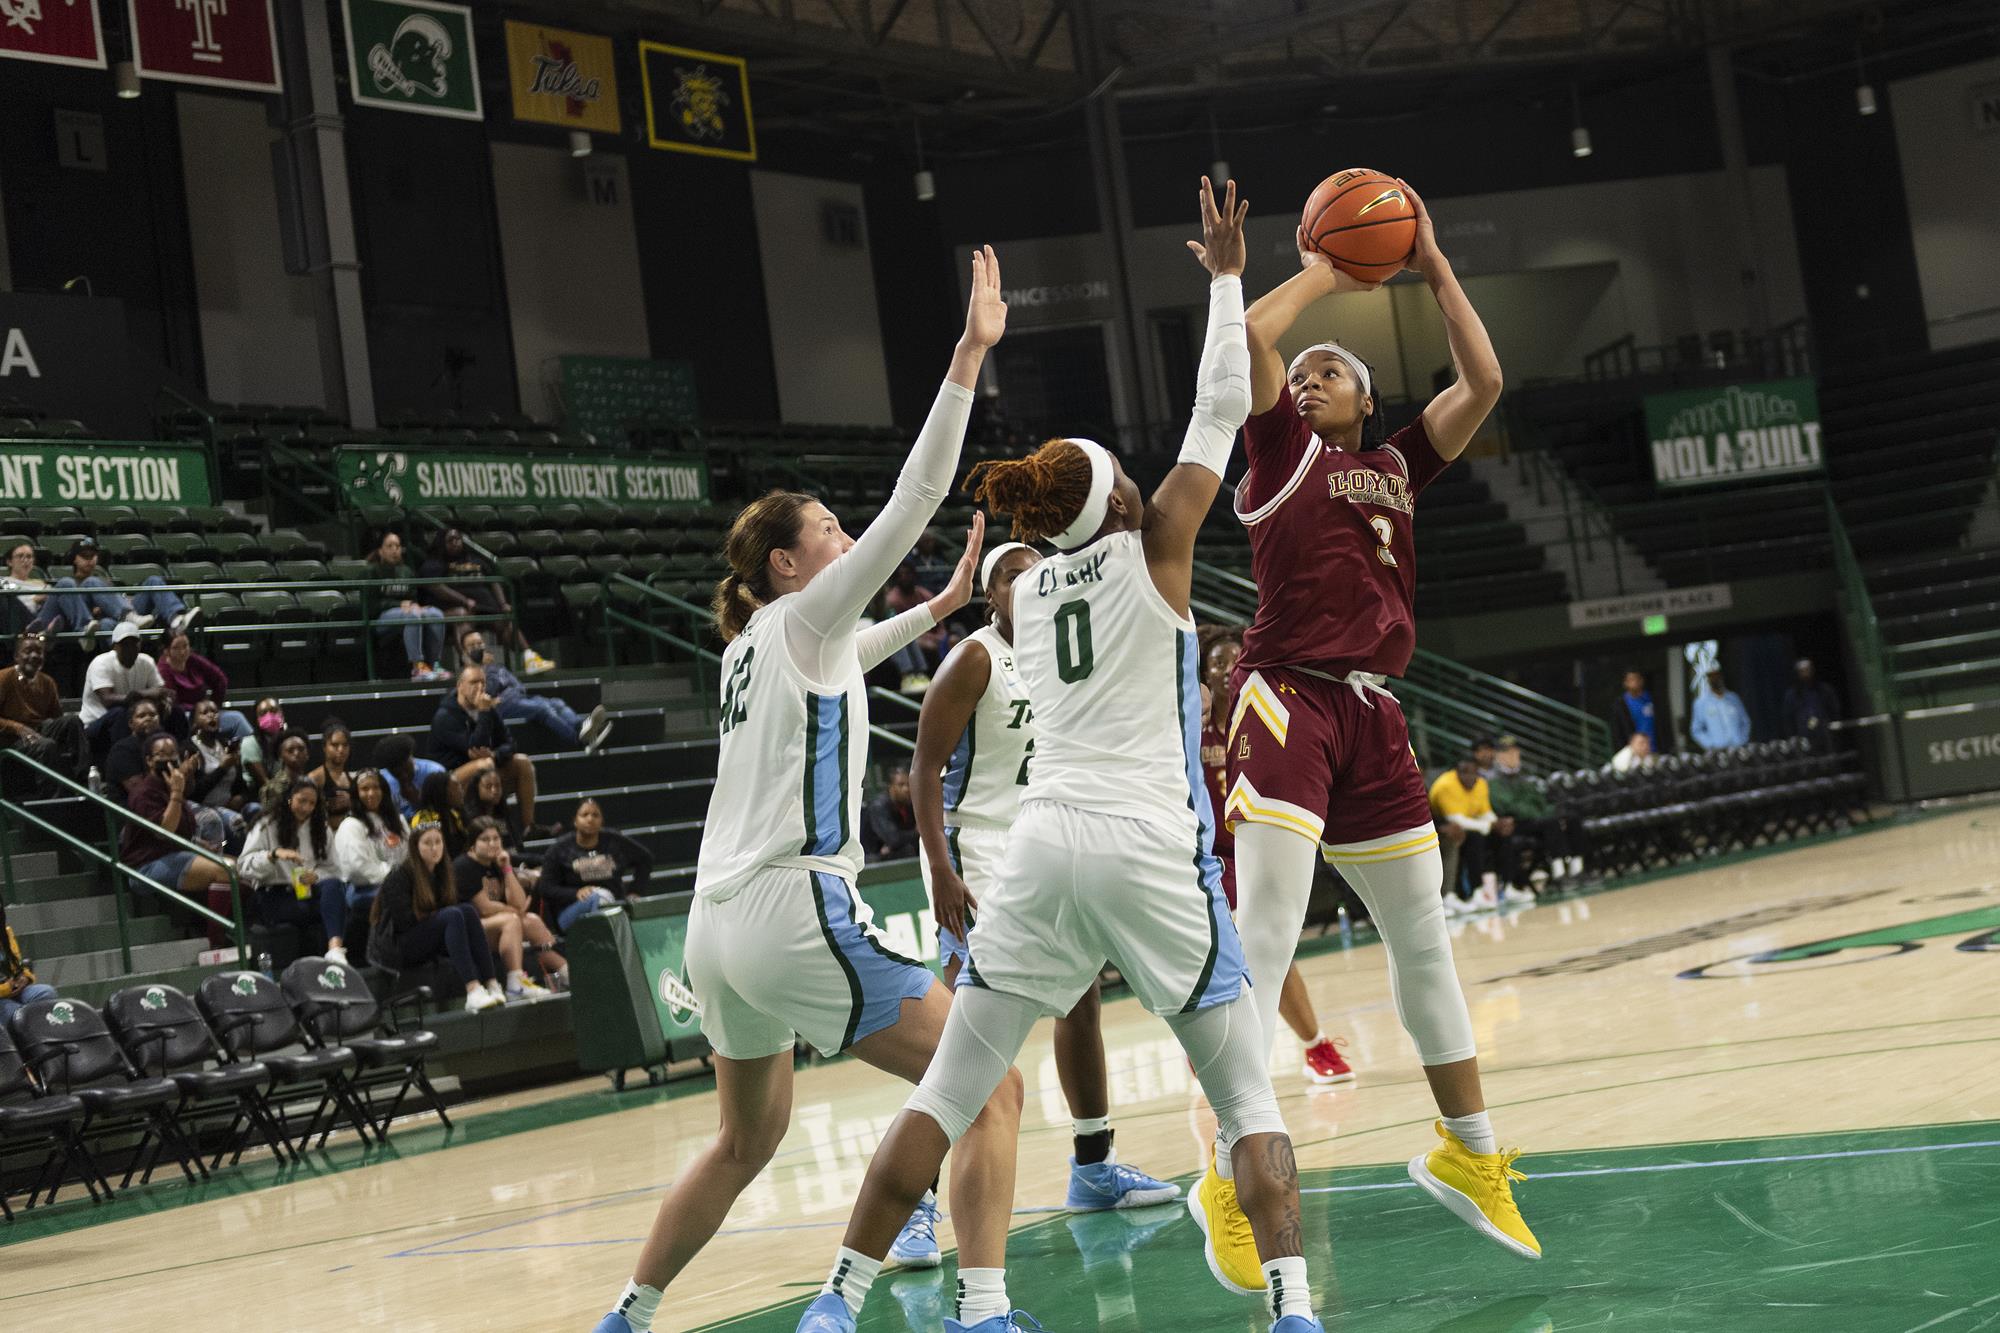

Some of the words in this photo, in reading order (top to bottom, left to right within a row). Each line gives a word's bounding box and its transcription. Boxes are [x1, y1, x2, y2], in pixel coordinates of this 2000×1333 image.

[529, 54, 601, 99] Tulsa
[1651, 432, 1737, 482] NOLA
[1736, 421, 1822, 470] BUILT
[0, 454, 43, 499] NT
[56, 455, 181, 501] SECTION
[416, 461, 528, 498] SAUNDERS
[531, 463, 619, 499] STUDENT
[624, 465, 700, 501] SECTION
[1054, 598, 1094, 685] 0
[1238, 733, 1251, 761] L
